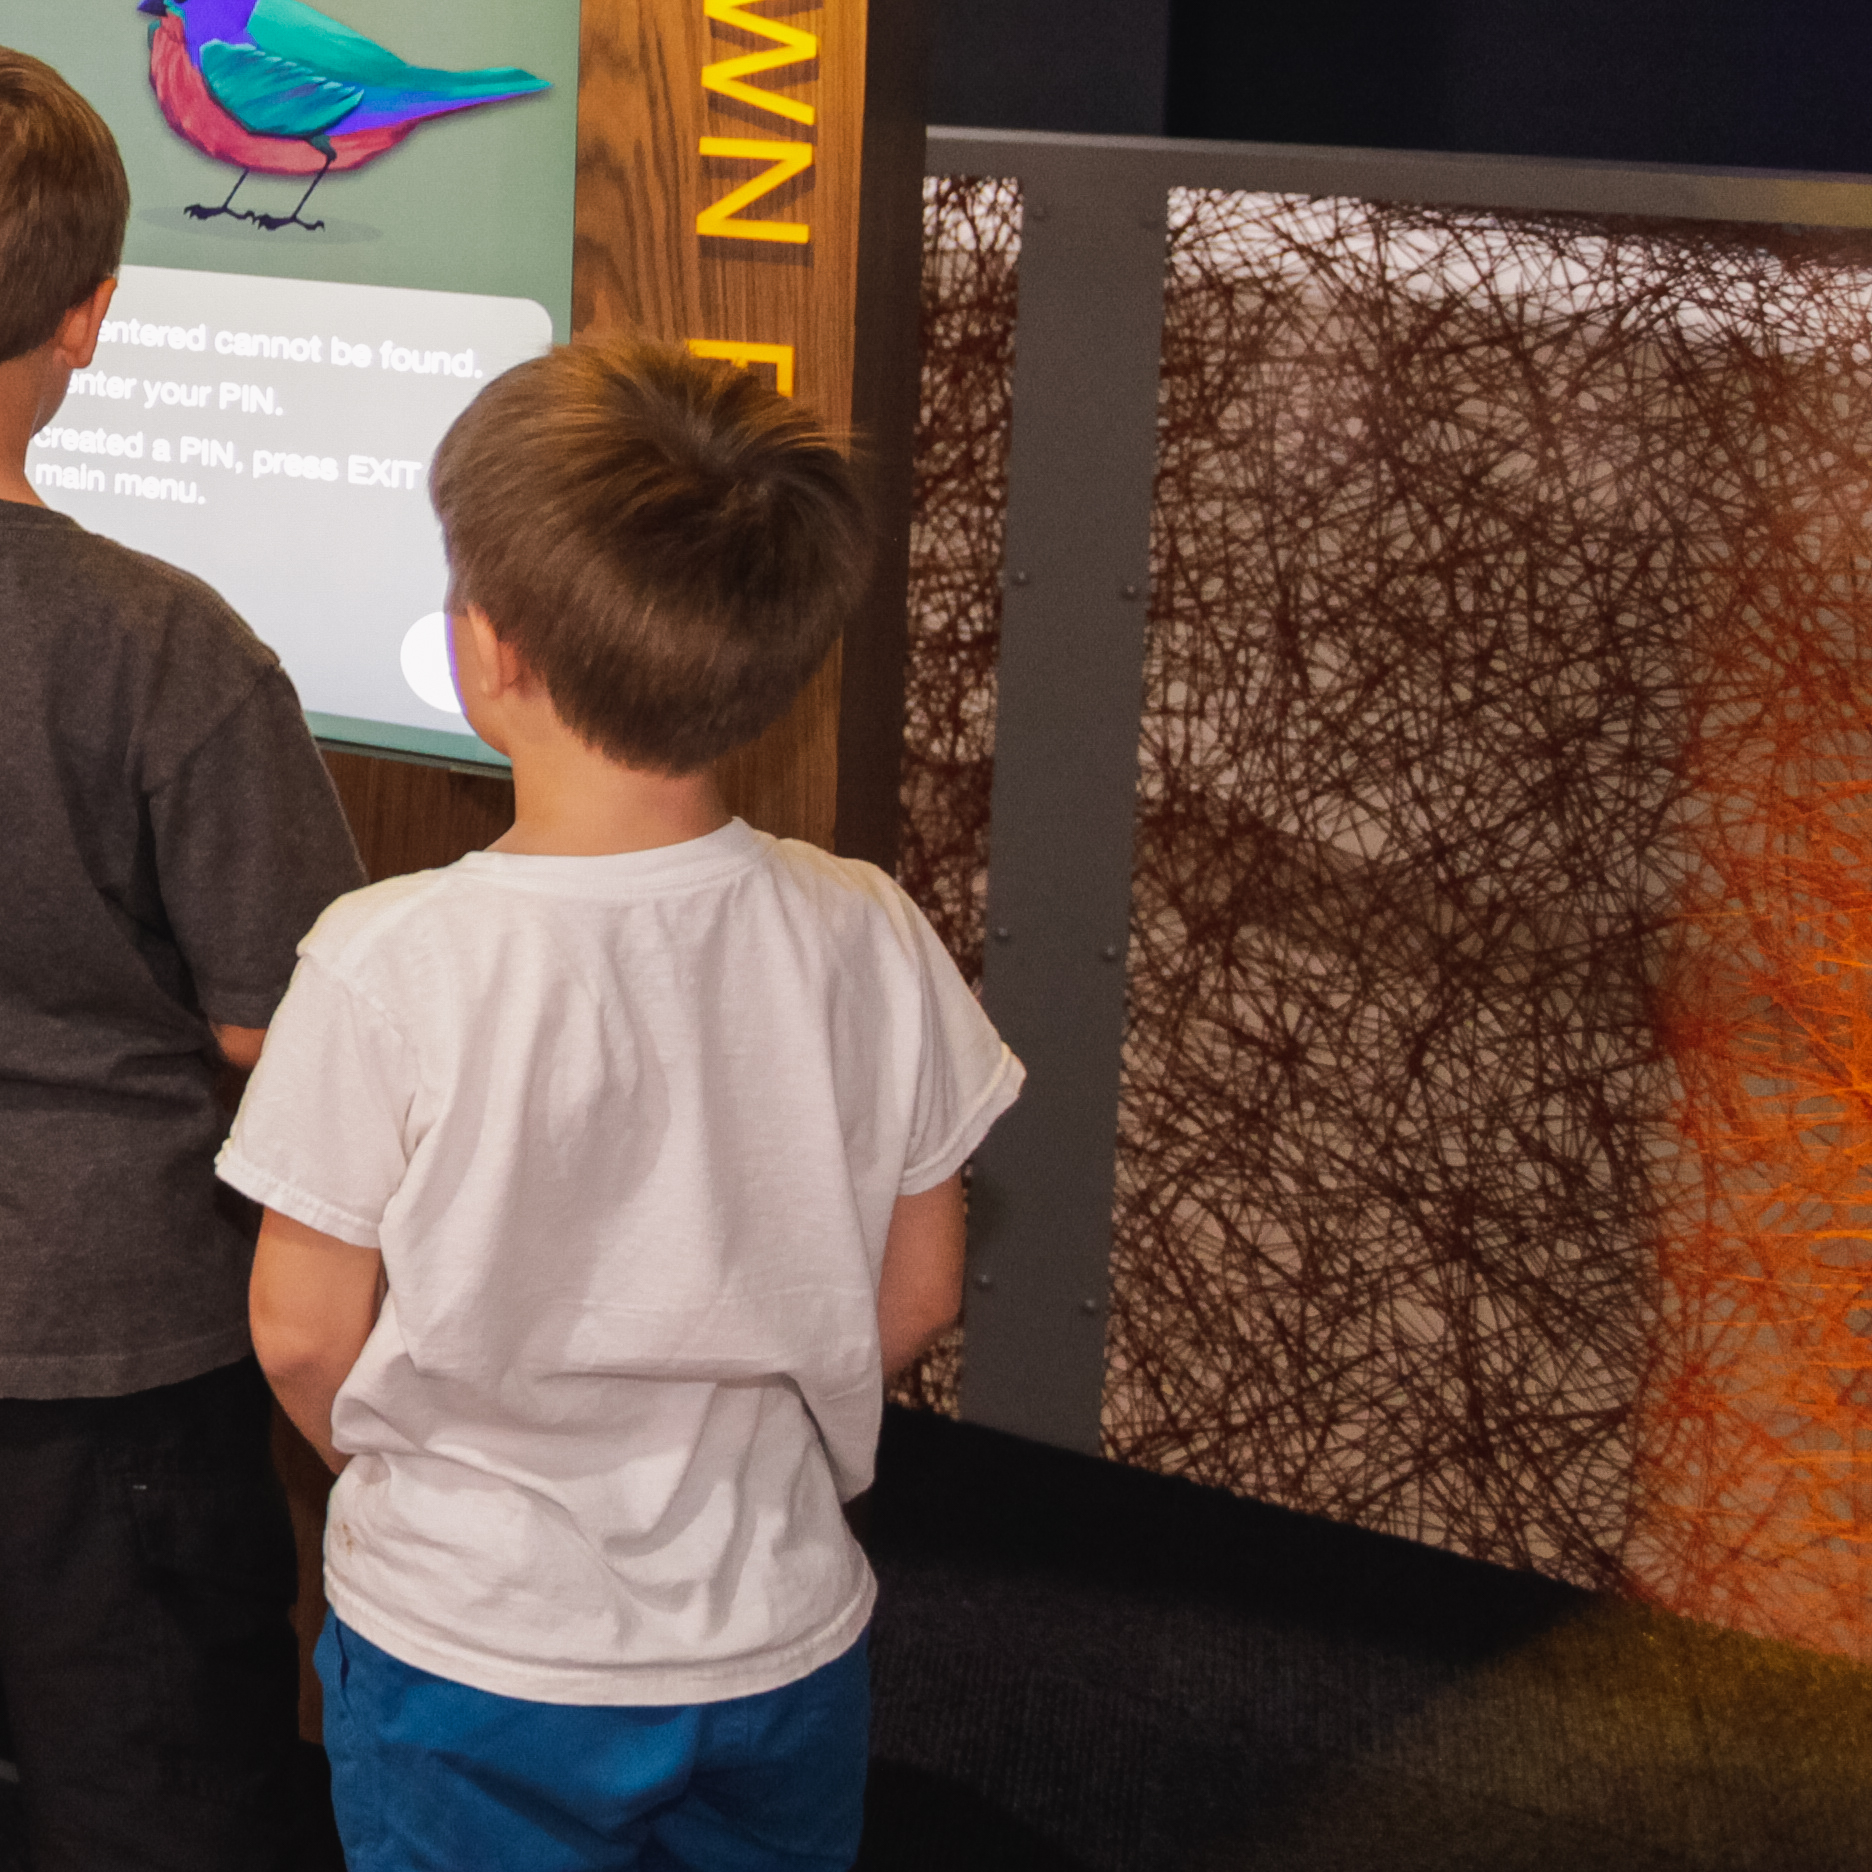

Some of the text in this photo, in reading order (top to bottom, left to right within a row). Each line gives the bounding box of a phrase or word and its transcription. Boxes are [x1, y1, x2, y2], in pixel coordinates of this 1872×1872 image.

[214, 330, 323, 363] cannot
[330, 335, 373, 368] be
[379, 339, 484, 379] found.
[142, 379, 213, 409] your
[219, 381, 284, 416] PIN.
[33, 426, 144, 459] created
[151, 437, 172, 463] a
[179, 435, 244, 474] PIN,
[252, 449, 339, 482] press
[347, 454, 424, 490] EXIT
[35, 462, 106, 492] main
[114, 471, 206, 505] menu.
